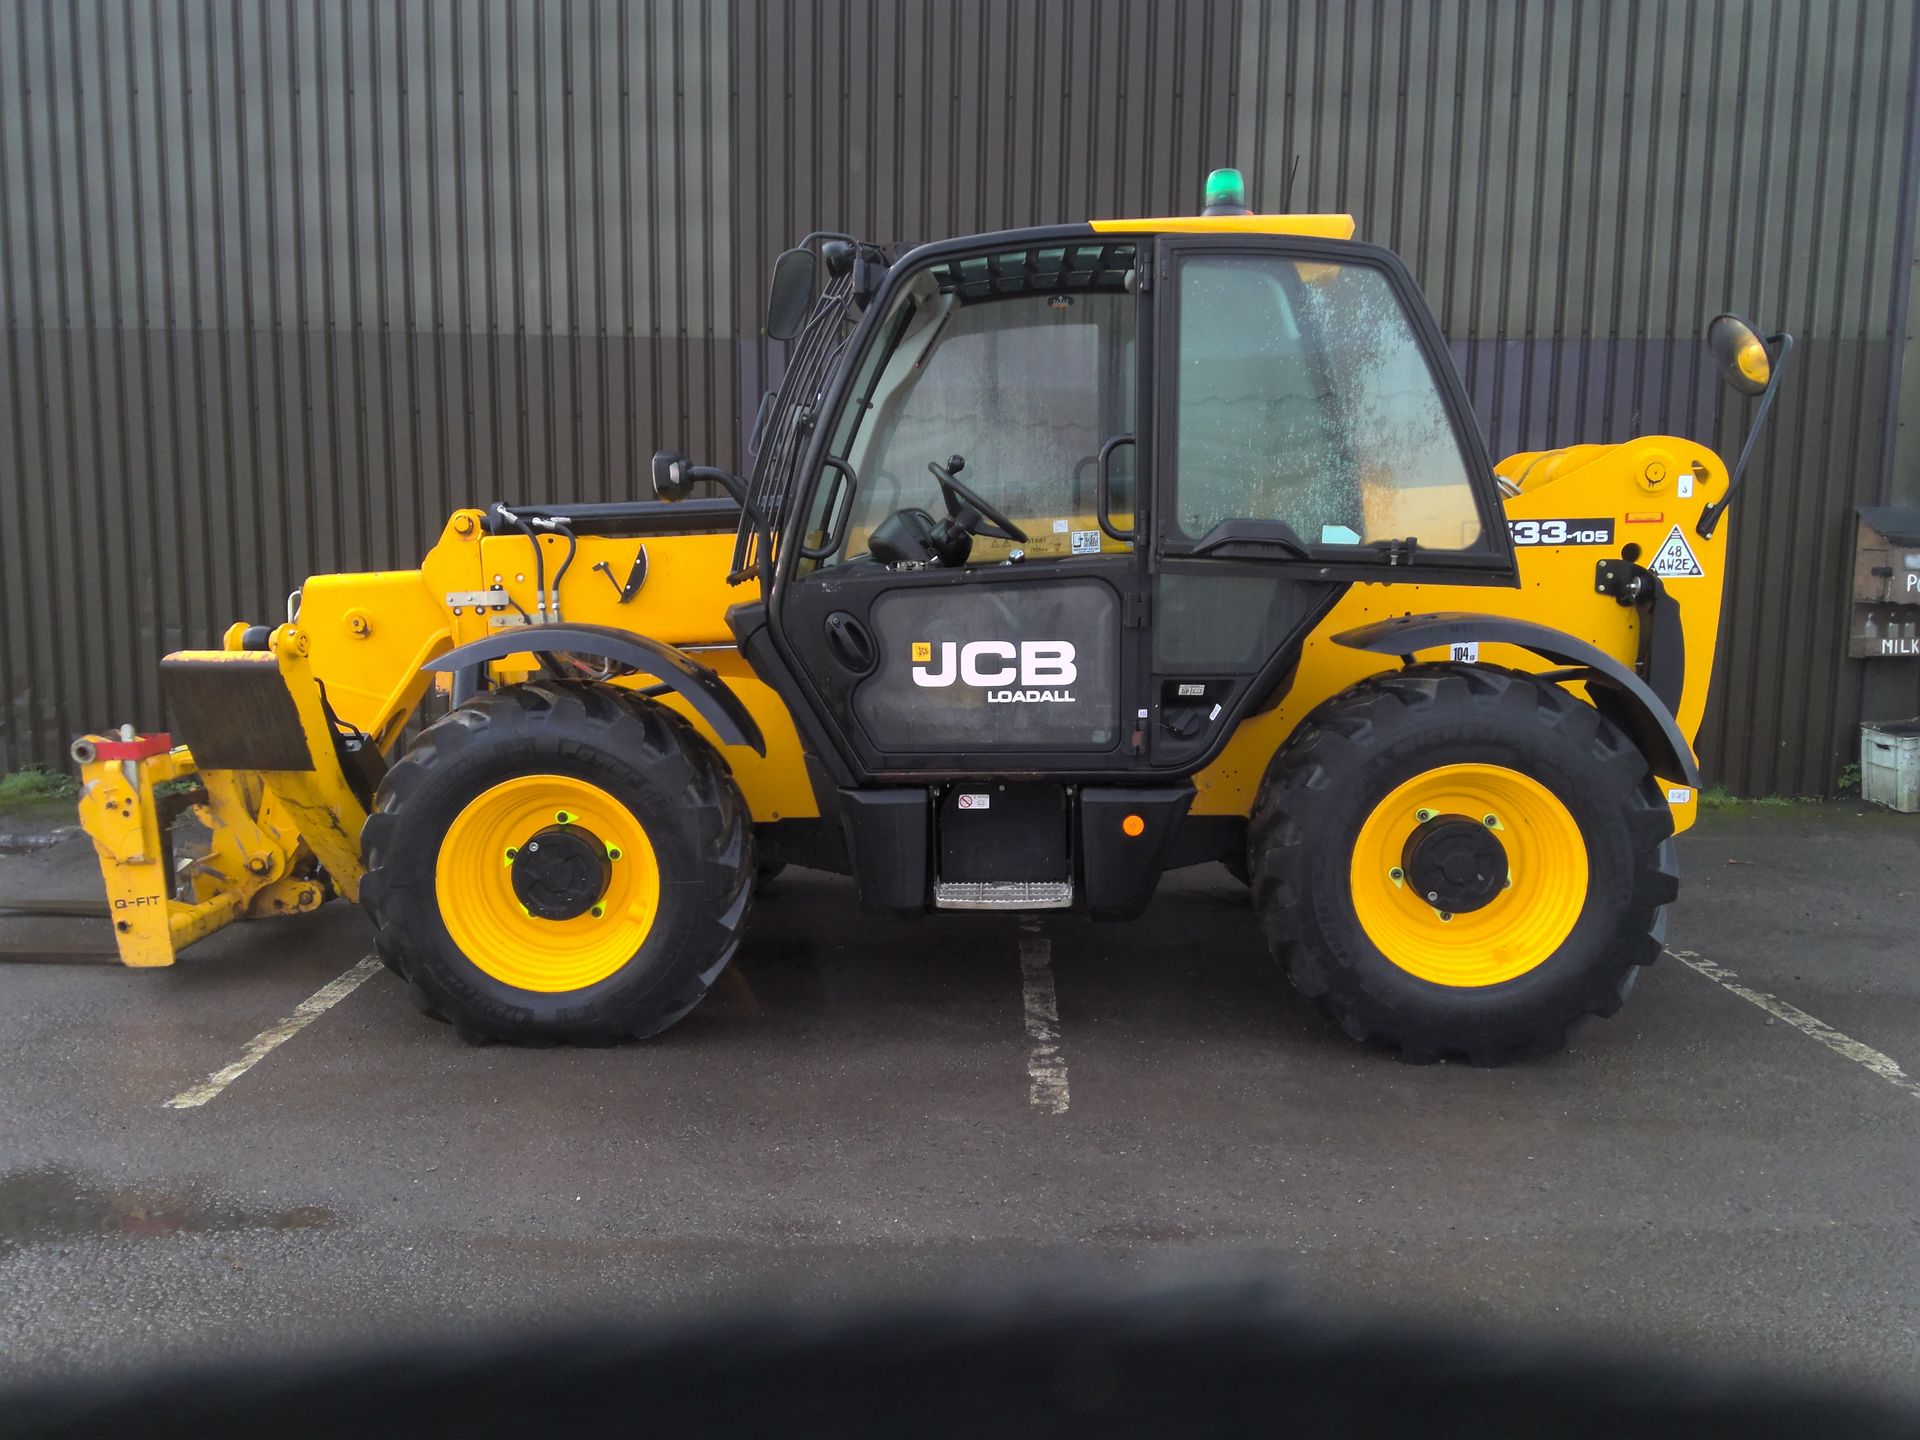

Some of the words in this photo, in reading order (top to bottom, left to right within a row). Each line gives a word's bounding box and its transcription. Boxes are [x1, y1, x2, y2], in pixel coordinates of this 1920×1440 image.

[1508, 521, 1608, 544] 33-105
[1668, 546, 1682, 557] 48
[1659, 559, 1690, 570] AW2E
[1882, 639, 1920, 654] MILK
[1454, 647, 1468, 662] 104
[912, 641, 1077, 687] JCB
[987, 690, 1076, 703] LOADALL
[114, 895, 160, 909] Q-FIT
